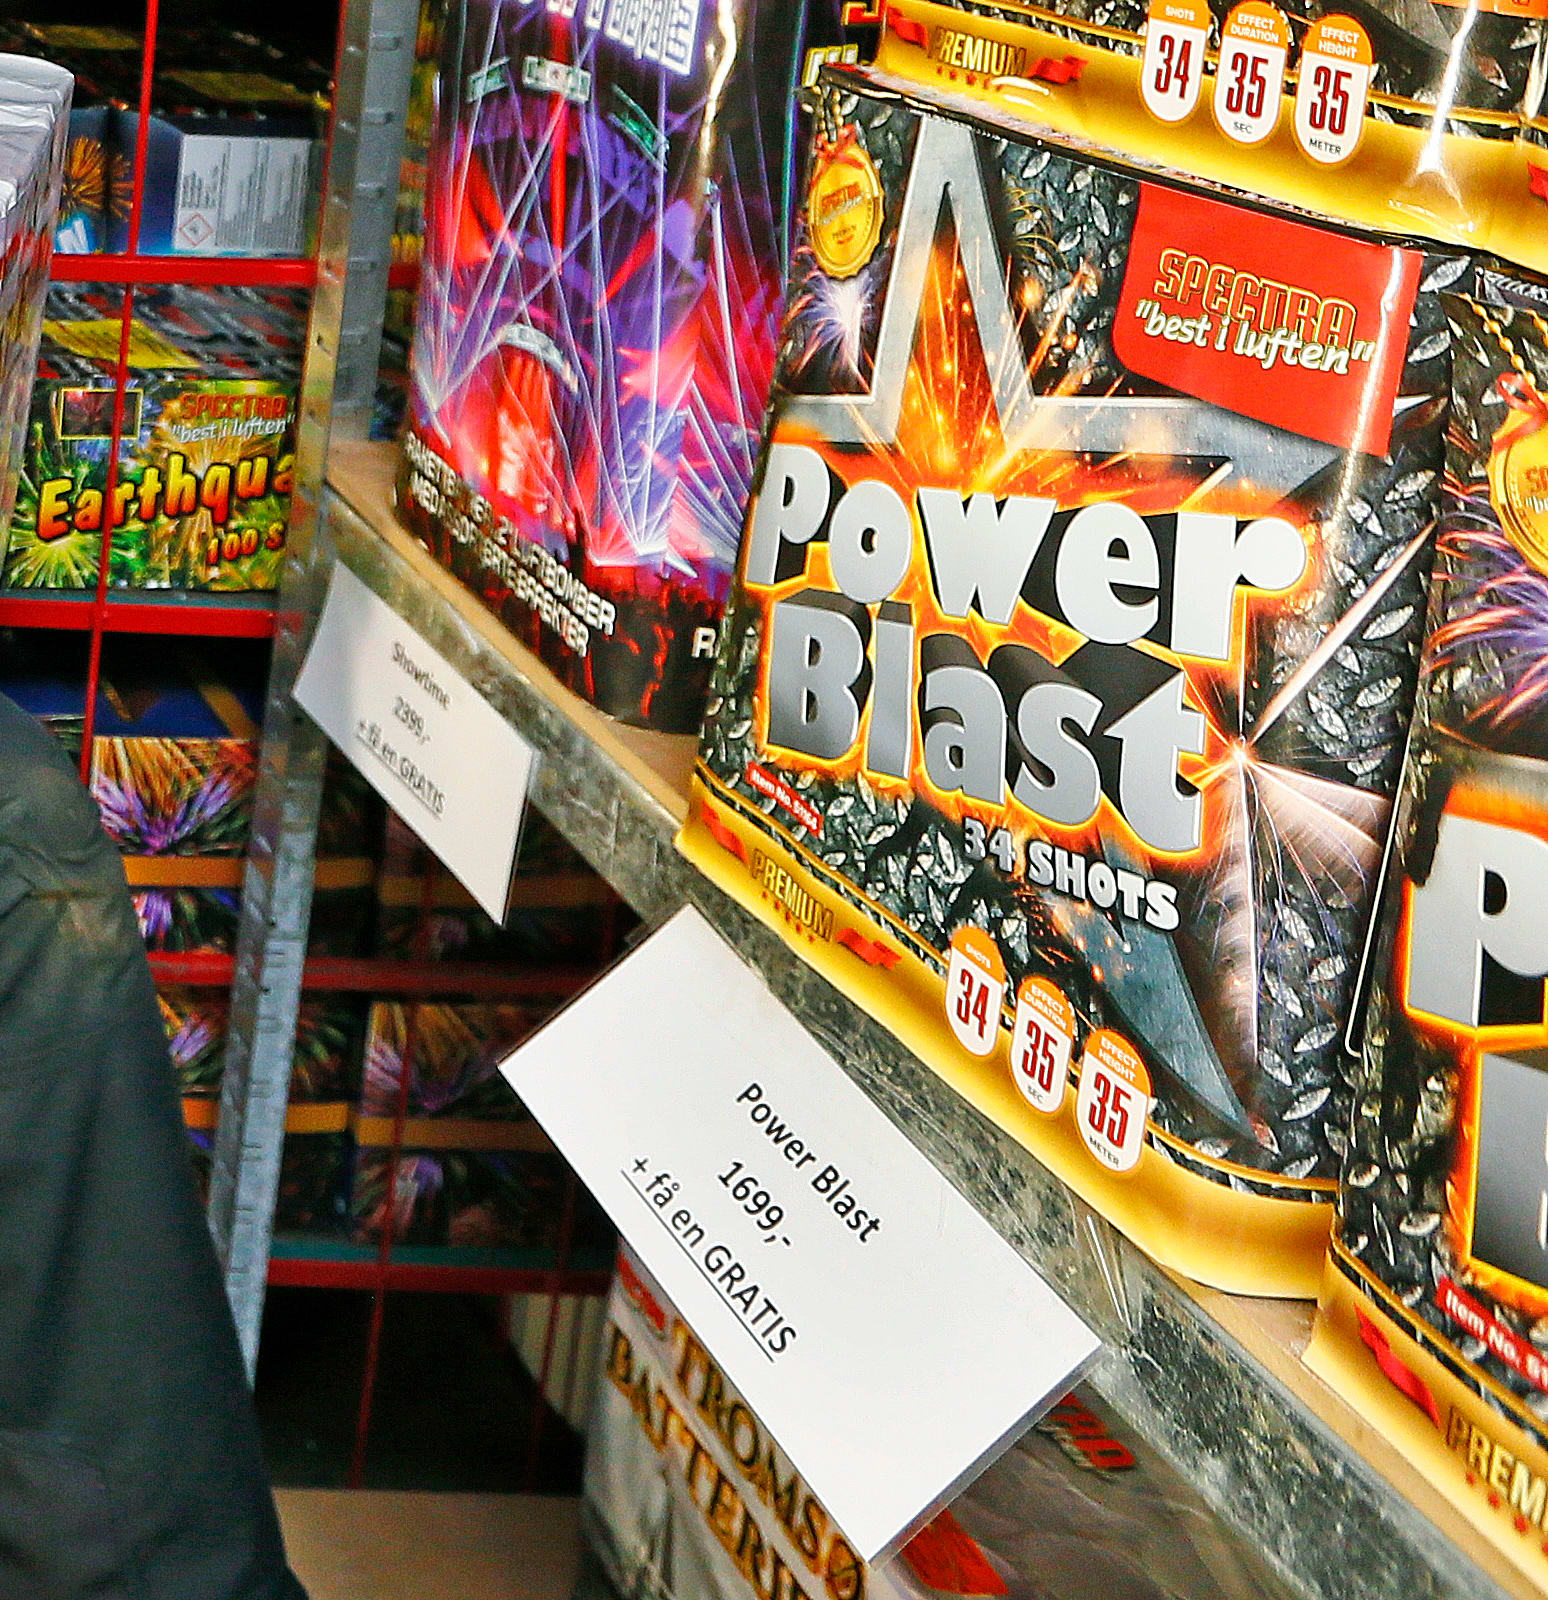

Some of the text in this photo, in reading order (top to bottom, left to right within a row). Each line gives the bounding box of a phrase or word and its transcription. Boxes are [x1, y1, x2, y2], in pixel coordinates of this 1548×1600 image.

[1165, 5, 1196, 22] SHOTS
[1230, 25, 1280, 44] DURATION
[1237, 12, 1276, 29] EFFECT
[1320, 25, 1360, 45] EFFECT
[929, 26, 1027, 77] PREMIUM
[1154, 33, 1192, 100] 34
[1318, 40, 1358, 59] HEIGHT
[1225, 51, 1269, 119] 35
[1309, 65, 1352, 136] 35
[1233, 120, 1253, 135] SEC
[1309, 137, 1342, 156] METER
[1153, 247, 1357, 348] SPECTRA
[1135, 298, 1376, 376] "best i luften"
[180, 391, 288, 420] SPECTRA
[206, 528, 260, 566] 100
[744, 442, 1306, 662] Power
[390, 641, 451, 711] Showtime
[767, 599, 1207, 852] Blast
[399, 757, 447, 815] GRATIS
[751, 847, 834, 942] PREMIUM
[964, 816, 1180, 932] 34 SHOTS
[956, 968, 989, 1040] 34
[1024, 990, 1067, 1030] DURATION
[1030, 983, 1065, 1013] EFFECT
[1021, 1019, 1058, 1093] 35
[1098, 1049, 1137, 1083] HEIGHT
[1100, 1036, 1139, 1070] EFFECT
[1026, 1084, 1044, 1105] SEC
[1088, 1071, 1132, 1149] 35
[735, 1082, 882, 1244] Power Blast
[1088, 1134, 1121, 1166] METER
[717, 1160, 792, 1248] 1699,-
[632, 1157, 798, 1355] + få en GRATIS
[1444, 1288, 1521, 1370] Item No.
